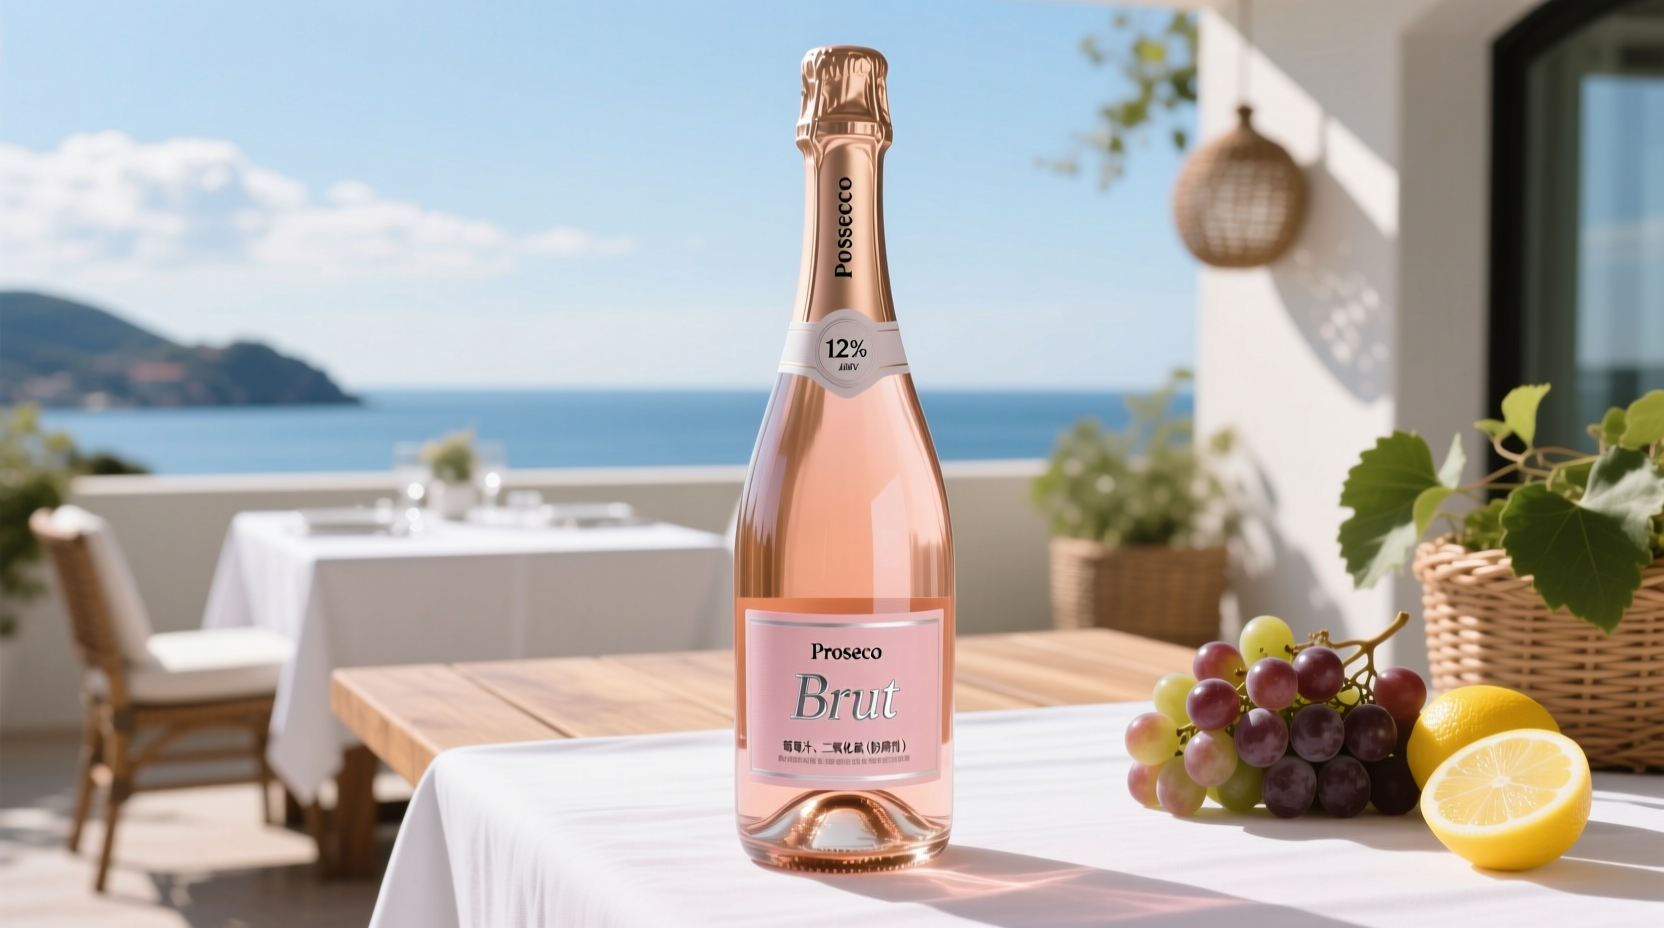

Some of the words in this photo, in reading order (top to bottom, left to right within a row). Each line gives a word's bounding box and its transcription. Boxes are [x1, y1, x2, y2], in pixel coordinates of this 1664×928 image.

[834, 176, 853, 279] Possecco
[825, 338, 867, 358] 12%
[811, 642, 882, 660] Proseco
[790, 672, 901, 721] Brut
